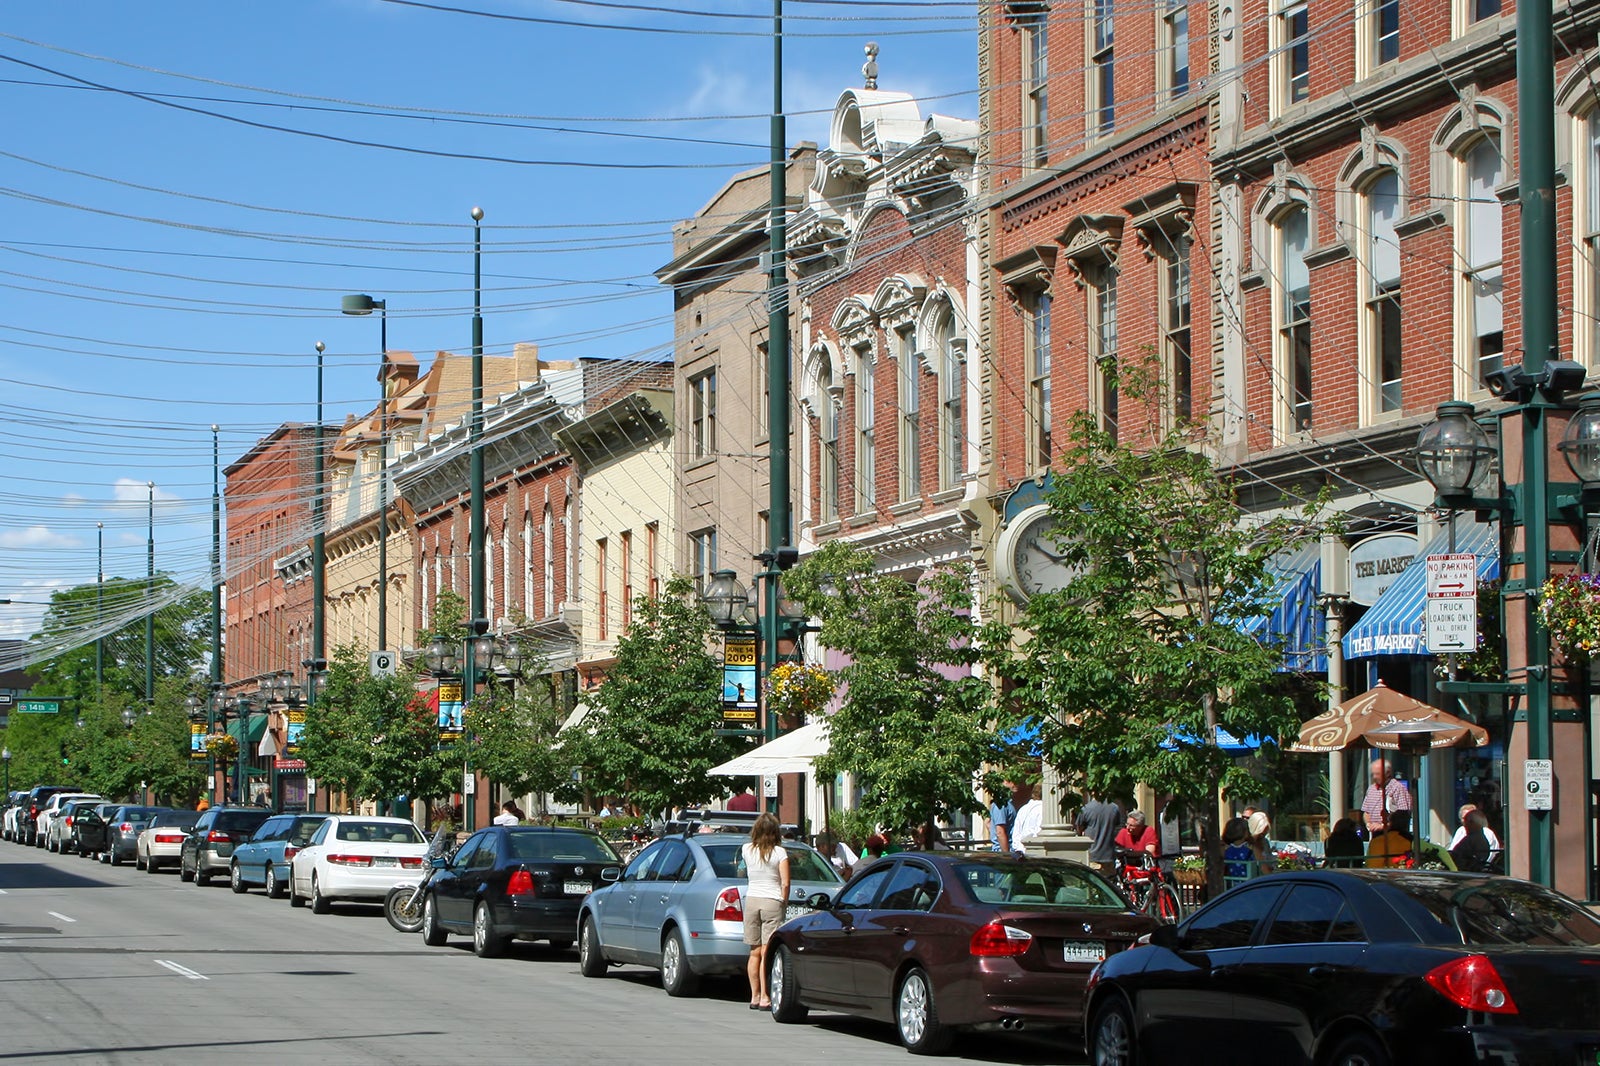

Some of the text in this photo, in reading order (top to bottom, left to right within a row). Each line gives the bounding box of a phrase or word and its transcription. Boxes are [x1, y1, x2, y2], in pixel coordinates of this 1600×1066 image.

[1021, 554, 1028, 565] 9
[1356, 560, 1375, 578] THE
[1442, 562, 1473, 572] PARKING
[1024, 569, 1032, 580] 8
[1034, 583, 1042, 594] 7
[1430, 614, 1455, 622] LOADING
[1352, 634, 1418, 653] THE MARKET
[728, 654, 754, 662] 2009
